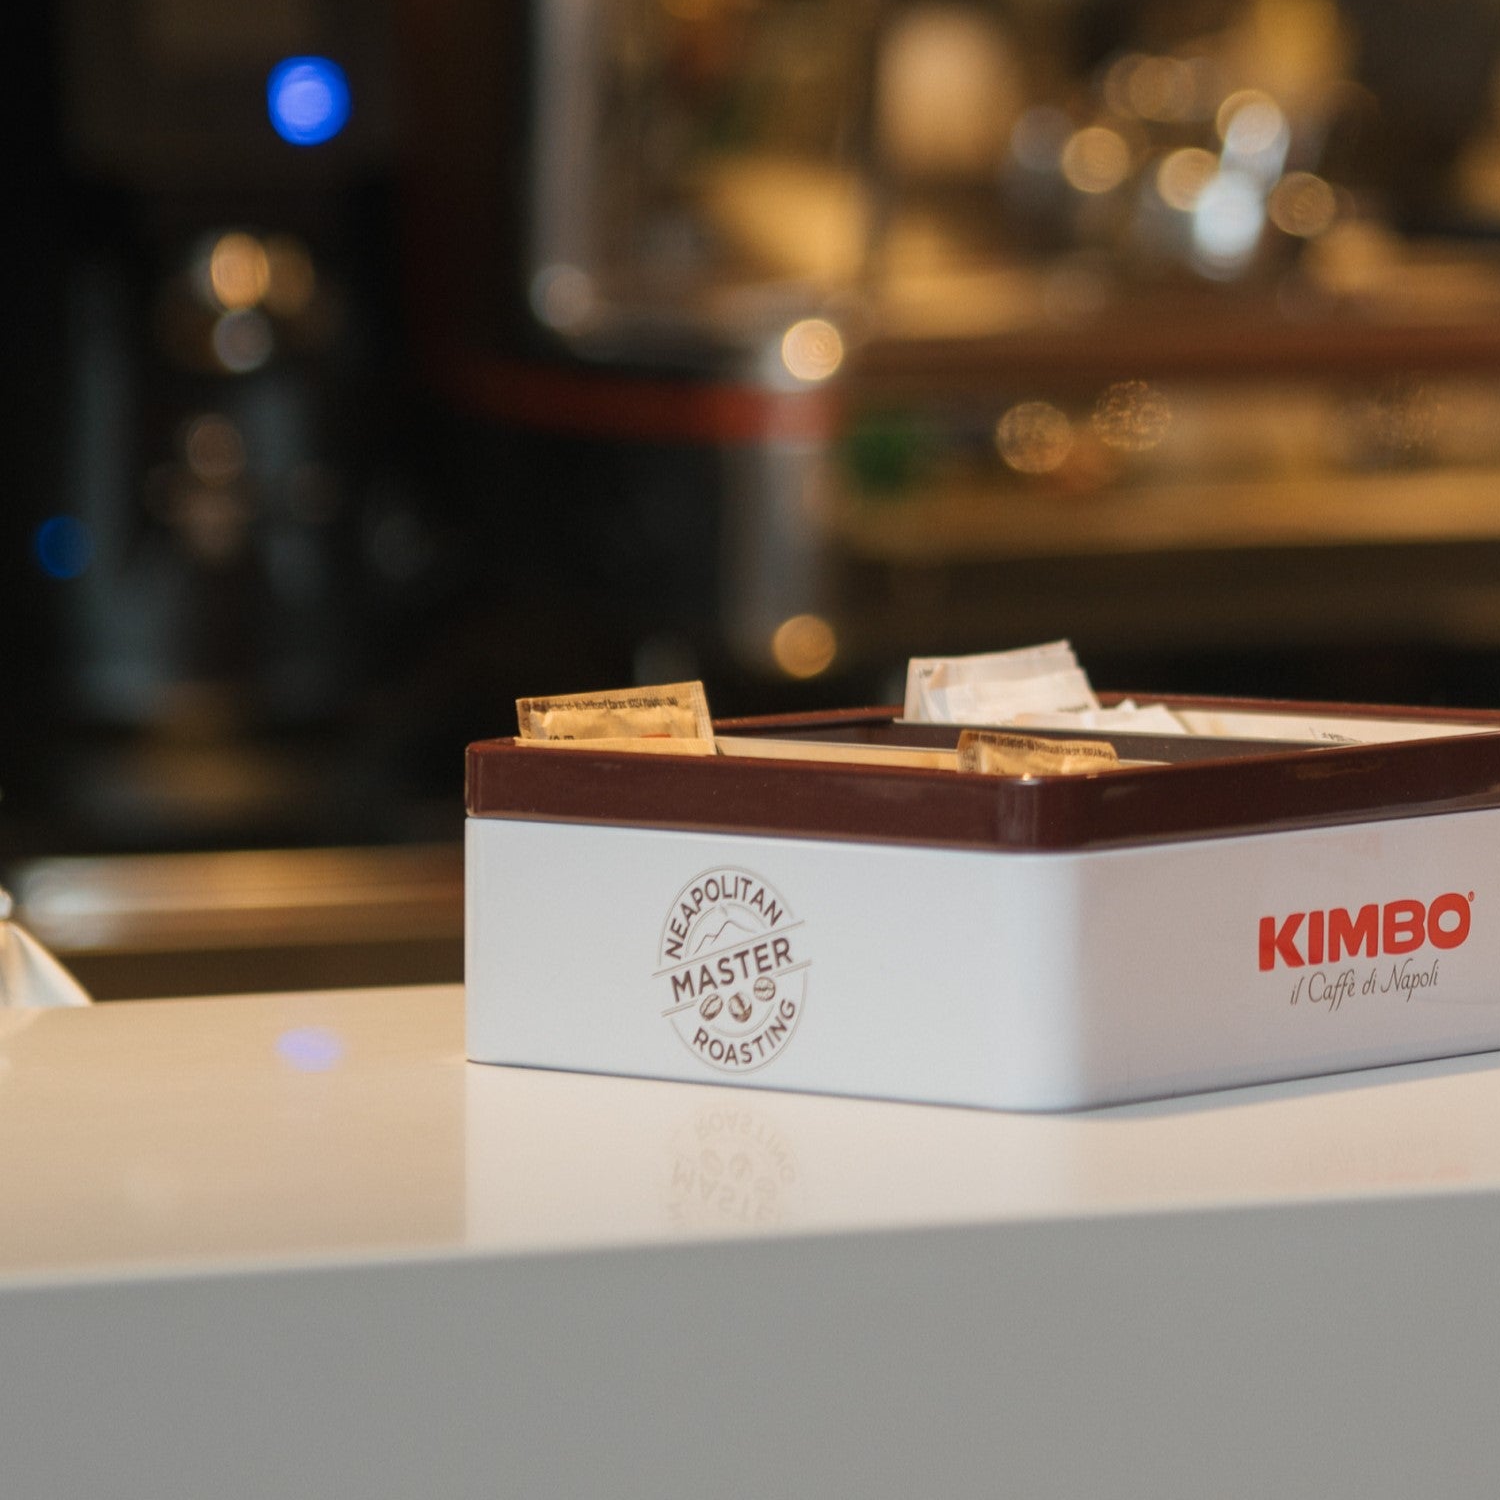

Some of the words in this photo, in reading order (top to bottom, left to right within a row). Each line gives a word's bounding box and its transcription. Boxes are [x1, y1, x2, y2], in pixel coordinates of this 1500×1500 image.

[664, 875, 783, 960] NEAPOLITAN
[1259, 891, 1471, 972] KIMBO
[670, 937, 793, 1003] MASTER
[1290, 976, 1305, 1005] il
[1308, 969, 1355, 1012] Caffè
[1362, 968, 1377, 996] di
[1380, 958, 1439, 1003] Napoli
[693, 999, 796, 1066] ROASTING
